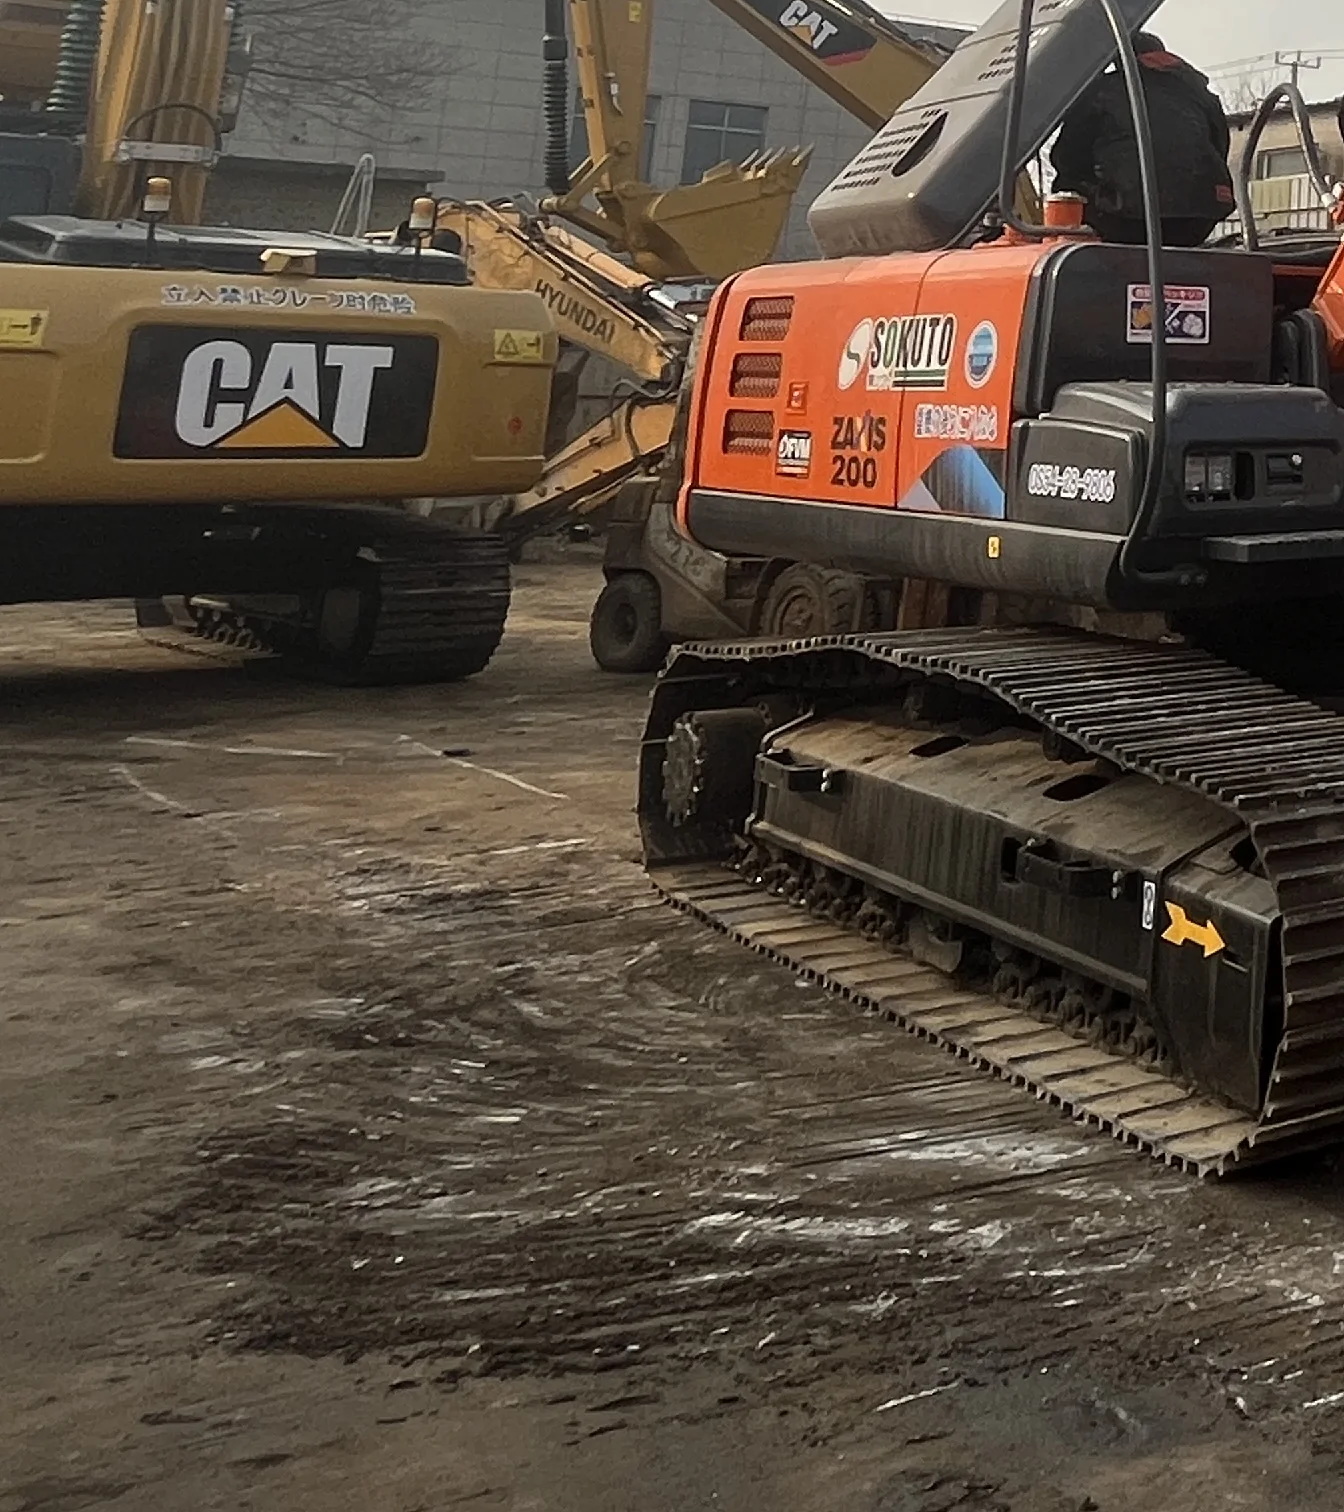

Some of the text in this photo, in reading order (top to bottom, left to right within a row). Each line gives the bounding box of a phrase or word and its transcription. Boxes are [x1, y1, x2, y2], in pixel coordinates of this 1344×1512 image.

[780, 0, 838, 49] CAT
[535, 279, 615, 344] HYUNDAI
[871, 317, 953, 368] SOKUTO
[175, 340, 394, 448] CAT
[831, 455, 877, 488] 200
